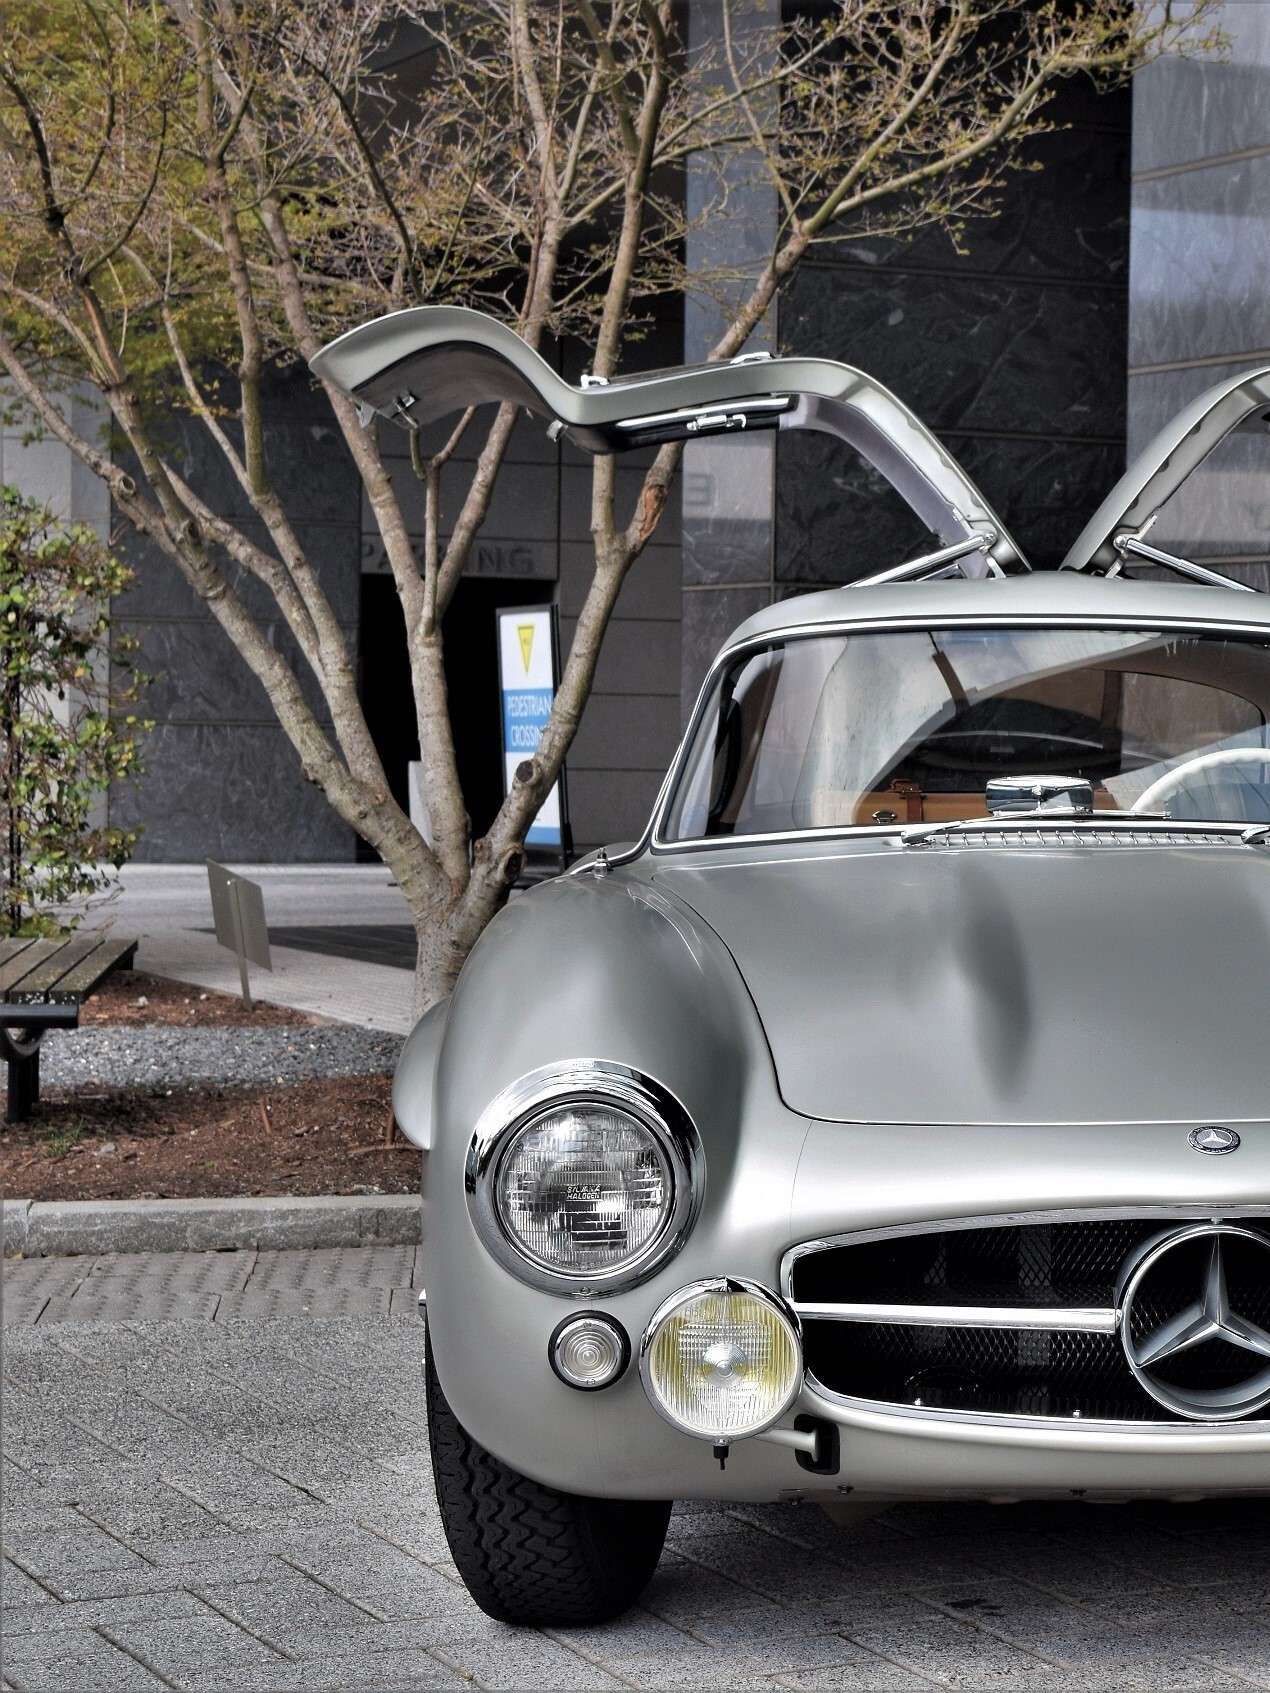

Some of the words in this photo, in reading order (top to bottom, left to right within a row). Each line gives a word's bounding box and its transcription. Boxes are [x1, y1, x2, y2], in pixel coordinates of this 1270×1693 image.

[360, 542, 533, 573] PANG
[507, 695, 552, 717] PEDESTRIAN
[511, 725, 546, 747] CROSSIN
